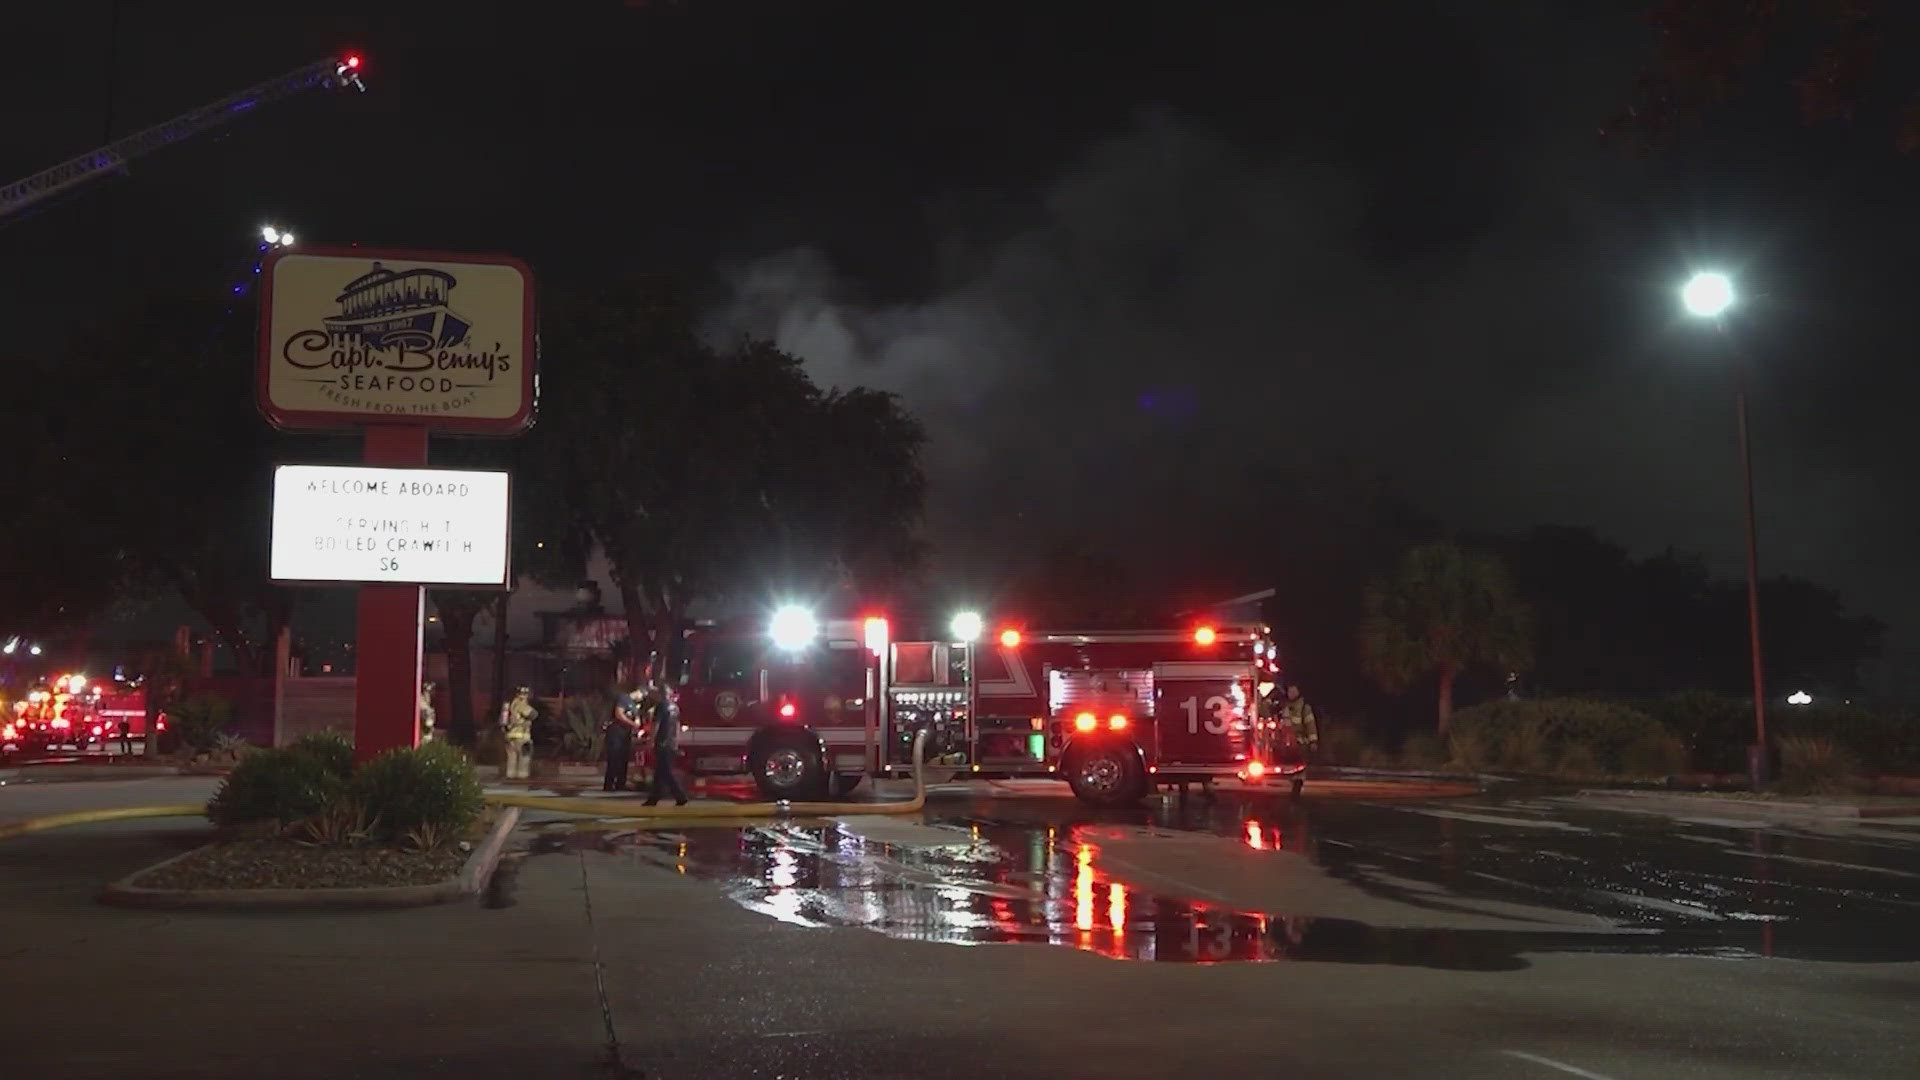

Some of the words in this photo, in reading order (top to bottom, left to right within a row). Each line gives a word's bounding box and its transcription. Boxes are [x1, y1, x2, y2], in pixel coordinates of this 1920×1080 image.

[283, 330, 384, 374] Capt.
[381, 330, 511, 382] Benny's
[340, 375, 454, 393] SEAFOOD
[318, 383, 361, 408] FRESH
[365, 401, 407, 415] FROM
[411, 403, 438, 414] THE
[442, 390, 478, 412] BOAT
[398, 481, 470, 498] ABOARD
[420, 519, 451, 533] HT
[386, 537, 473, 553] CRAWFIH
[1181, 696, 1232, 735] 13
